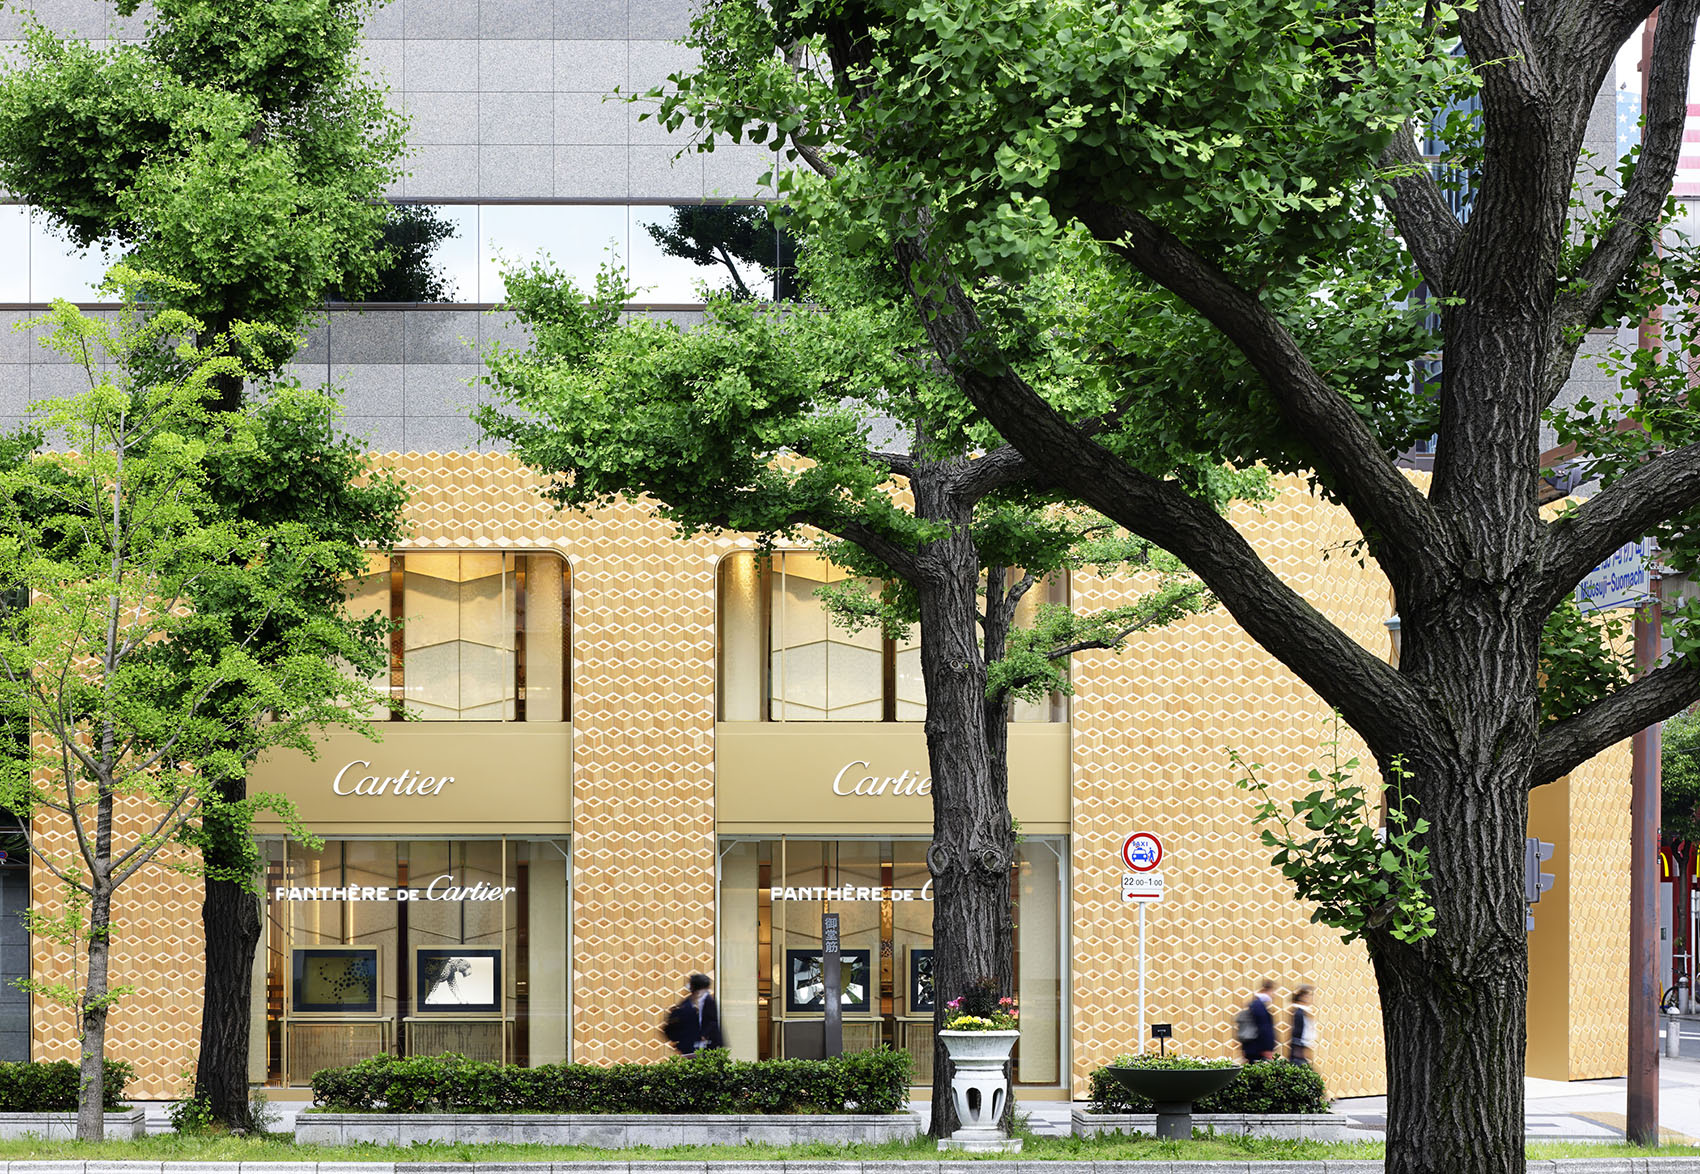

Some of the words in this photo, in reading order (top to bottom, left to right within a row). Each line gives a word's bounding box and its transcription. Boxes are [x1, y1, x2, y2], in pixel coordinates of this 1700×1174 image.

[332, 759, 455, 797] Cartier
[832, 760, 932, 797] Cartie
[275, 883, 390, 901] PANTHÈRE
[397, 889, 419, 901] DE
[426, 875, 516, 902] Cartier
[770, 883, 884, 901] PANTHÈRE
[891, 889, 914, 901] DE
[825, 917, 838, 953] 御堂筋
